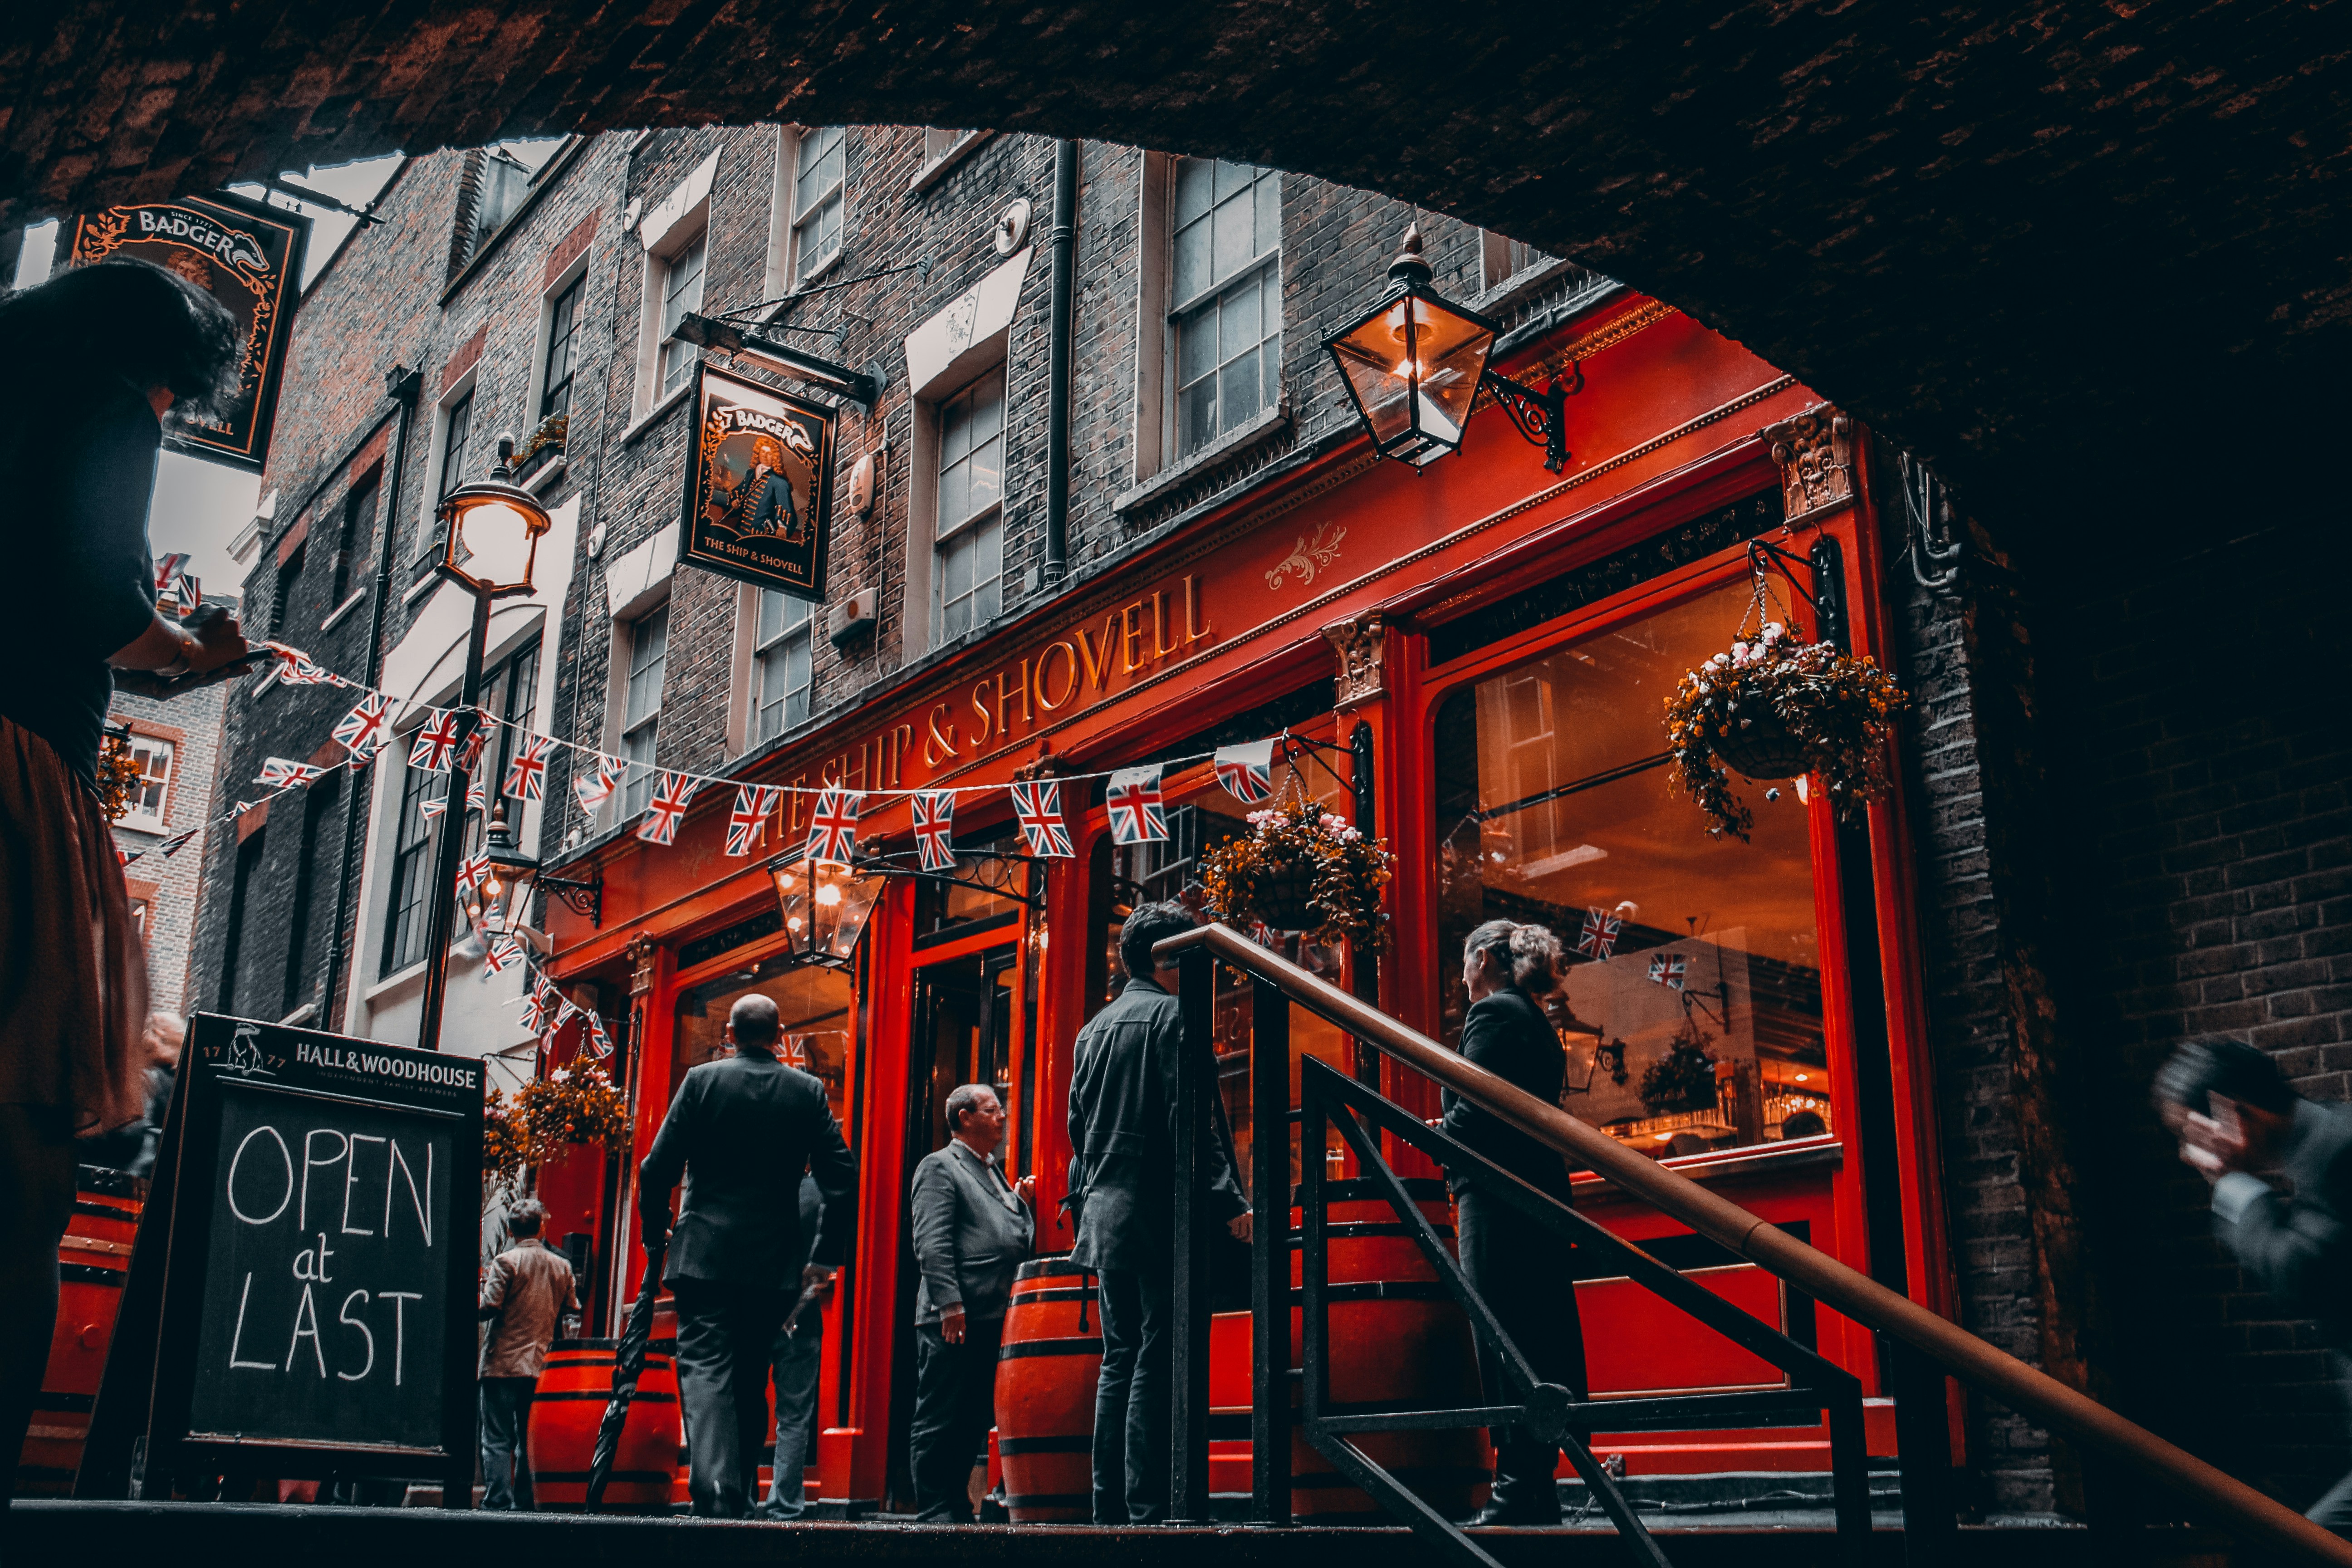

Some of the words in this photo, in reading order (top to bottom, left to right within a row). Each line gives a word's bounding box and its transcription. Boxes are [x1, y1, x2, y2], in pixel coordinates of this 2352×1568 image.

[138, 211, 235, 266] BADGER
[170, 211, 193, 221] SINCE
[196, 218, 214, 229] 1777
[736, 410, 794, 449] BADGER
[704, 536, 725, 552] THE
[726, 543, 750, 562] SHIP
[751, 549, 759, 562] &
[760, 554, 804, 576] SHOVELL
[744, 773, 807, 855] HE
[821, 724, 911, 799] SHIP
[923, 703, 960, 769] &
[969, 573, 1212, 747] SHOVELL
[203, 1046, 221, 1058] 17
[266, 1054, 286, 1068] 77
[316, 1070, 380, 1085] INDEPENDENT
[384, 1081, 415, 1091] FAMILY
[418, 1086, 458, 1098] BREWERS
[227, 1125, 434, 1247] OPEN
[292, 1232, 335, 1283] at
[229, 1271, 423, 1387] LAST
